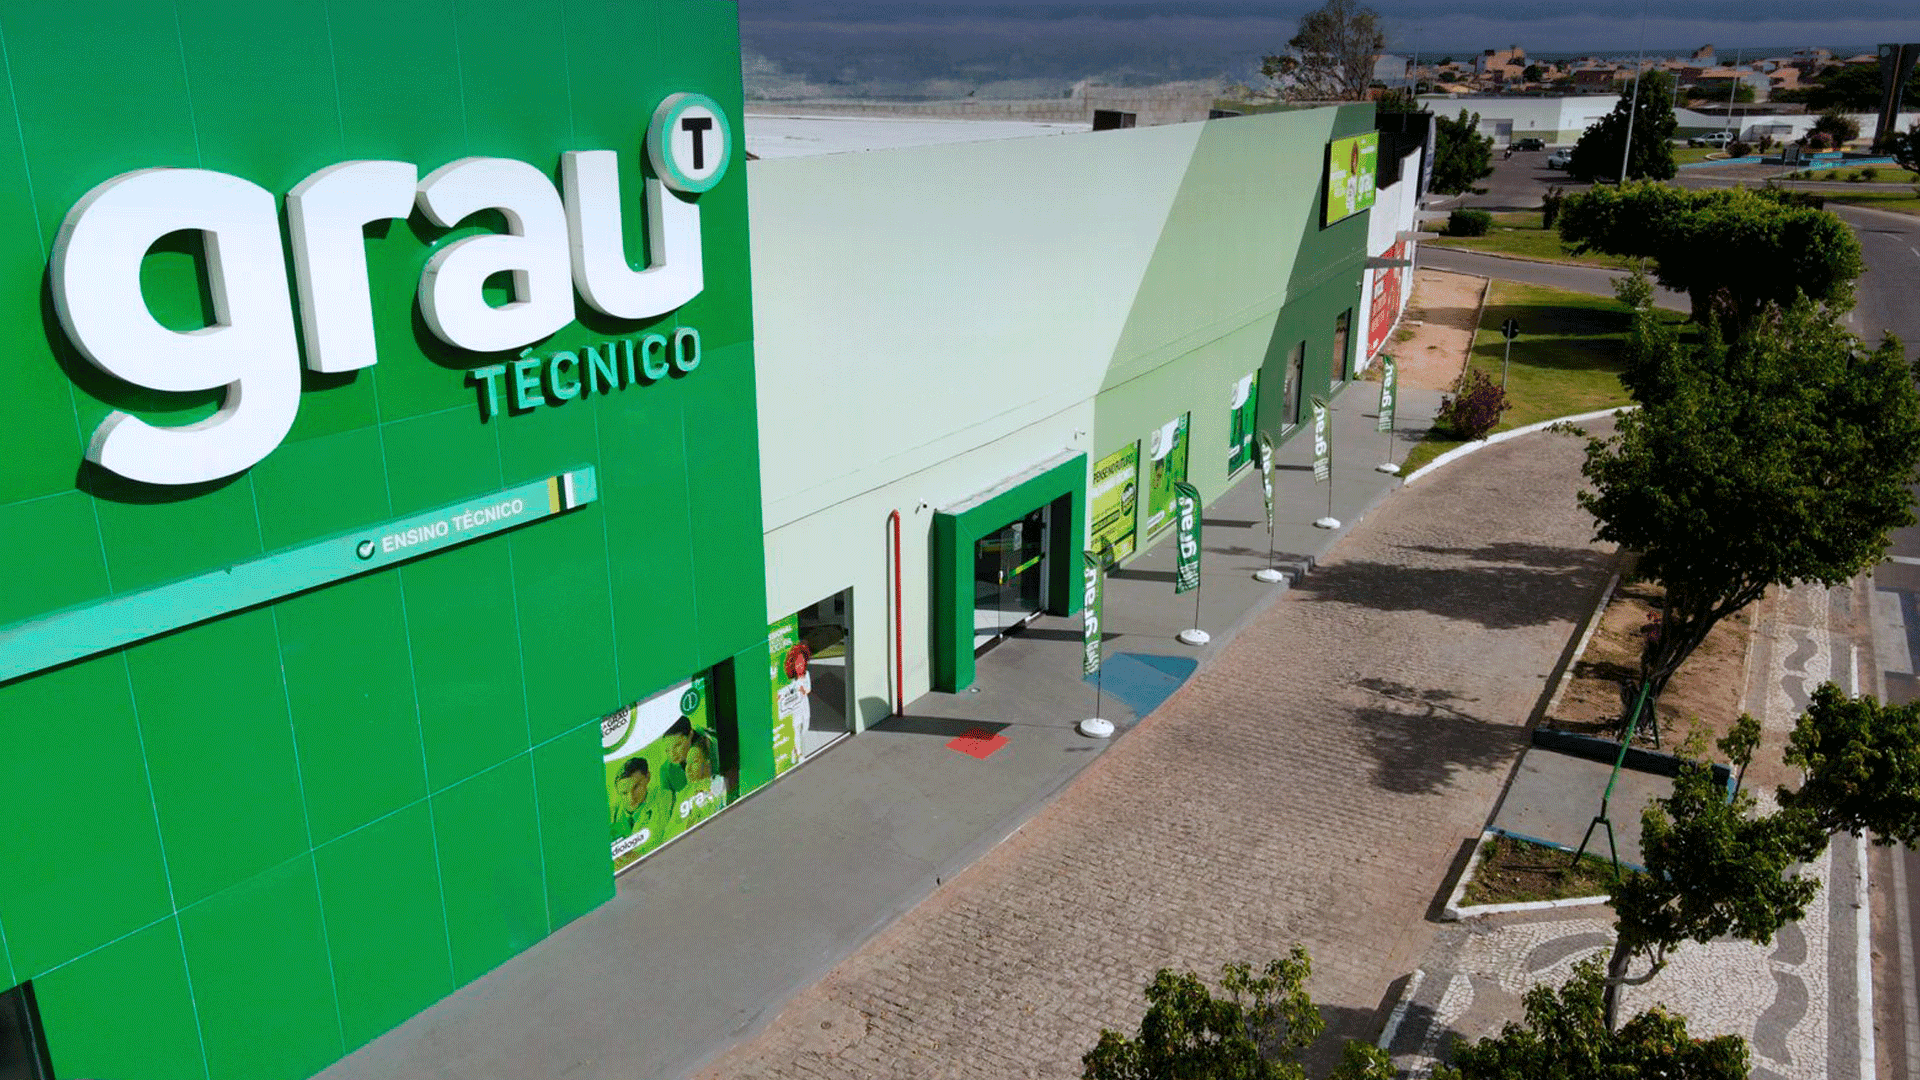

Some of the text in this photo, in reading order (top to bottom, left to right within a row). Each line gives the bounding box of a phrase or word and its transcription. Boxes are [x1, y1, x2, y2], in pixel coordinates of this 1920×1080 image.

[681, 117, 712, 170] T
[51, 149, 705, 485] grau
[474, 326, 701, 417] TÉCNICO
[1314, 406, 1327, 456] grau
[382, 499, 523, 553] ENSINO TÉCNICO
[1179, 498, 1197, 559] grau
[1084, 568, 1098, 638] grau
